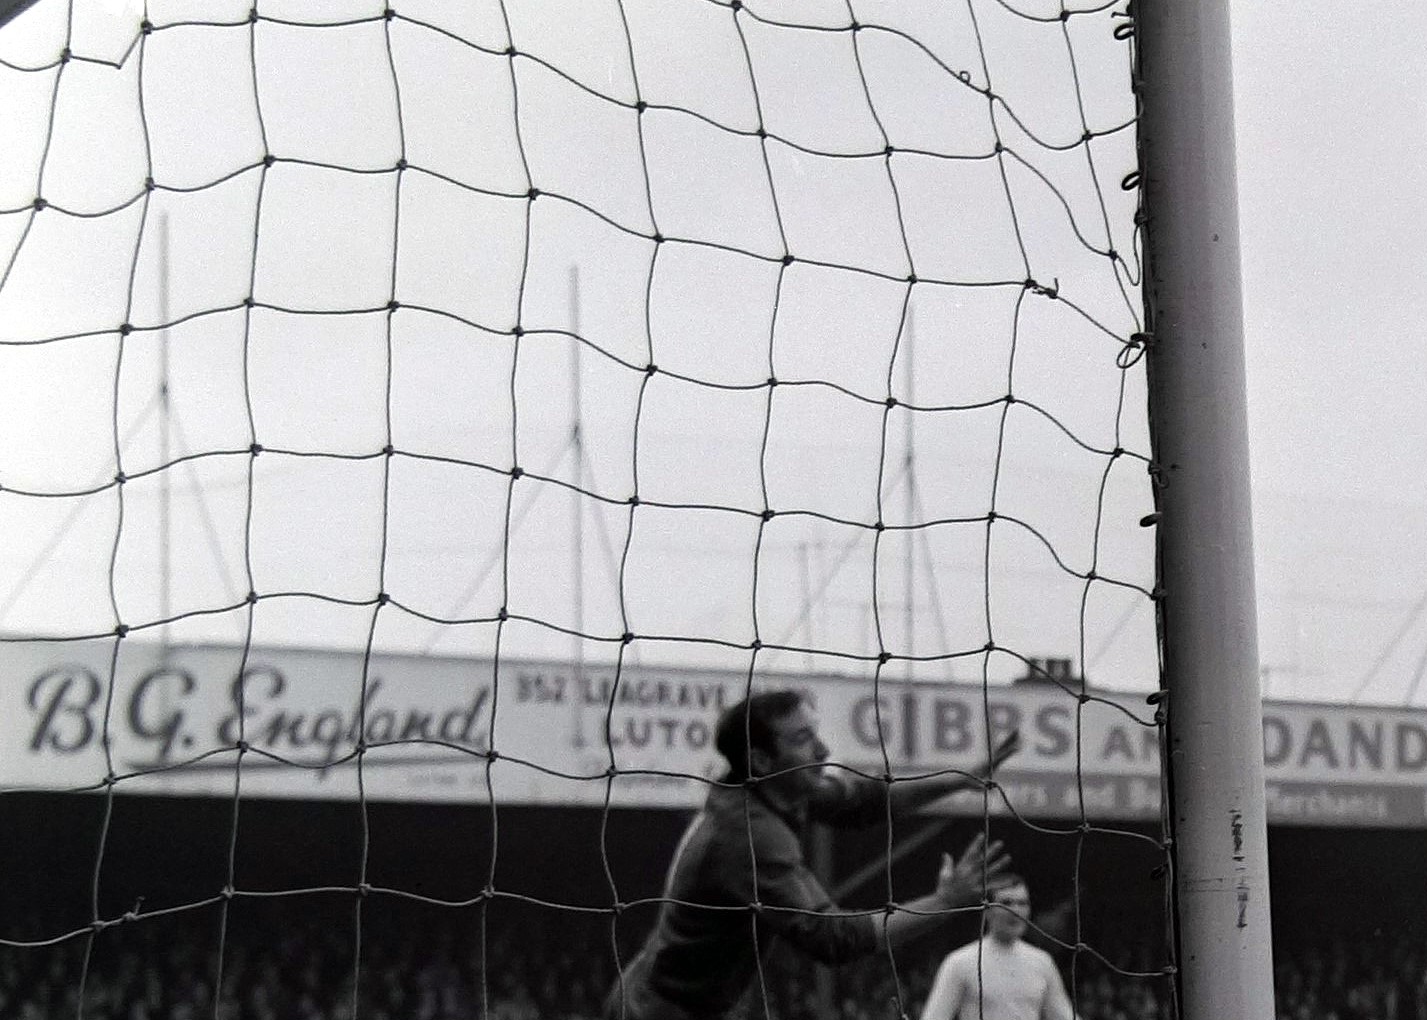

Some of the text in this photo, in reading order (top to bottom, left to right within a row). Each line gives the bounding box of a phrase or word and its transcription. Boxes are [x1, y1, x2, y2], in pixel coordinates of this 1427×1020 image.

[127, 668, 194, 759] G.
[603, 717, 709, 750] LUTO
[850, 694, 1071, 760] GIBBS
